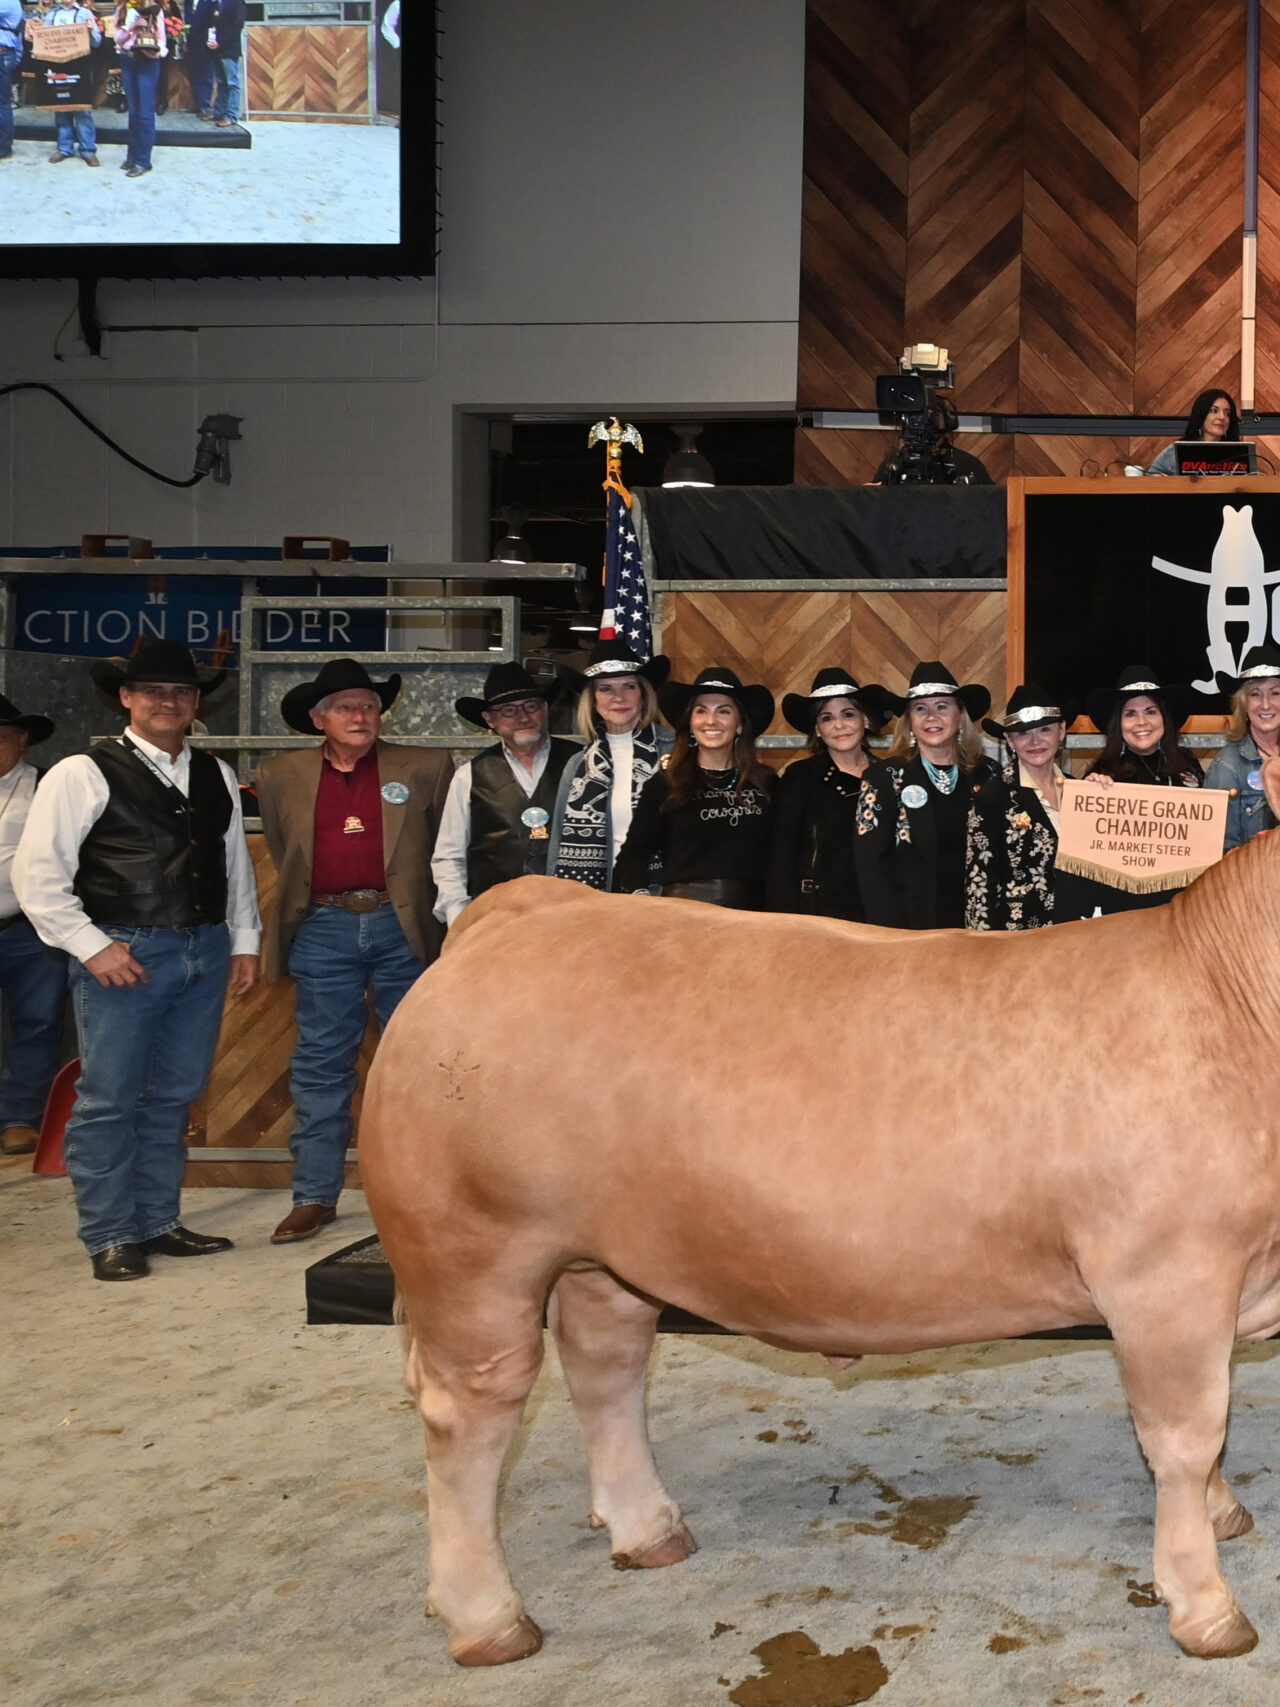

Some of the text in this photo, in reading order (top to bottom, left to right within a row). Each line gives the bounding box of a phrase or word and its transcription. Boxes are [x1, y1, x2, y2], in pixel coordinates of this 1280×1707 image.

[24, 609, 167, 643] CTION
[1074, 795, 1213, 822] RESERVE GRAND
[1095, 817, 1189, 841] CHAMPION
[1089, 839, 1191, 857] JR. MARKET STEER
[1122, 855, 1156, 868] SHOW
